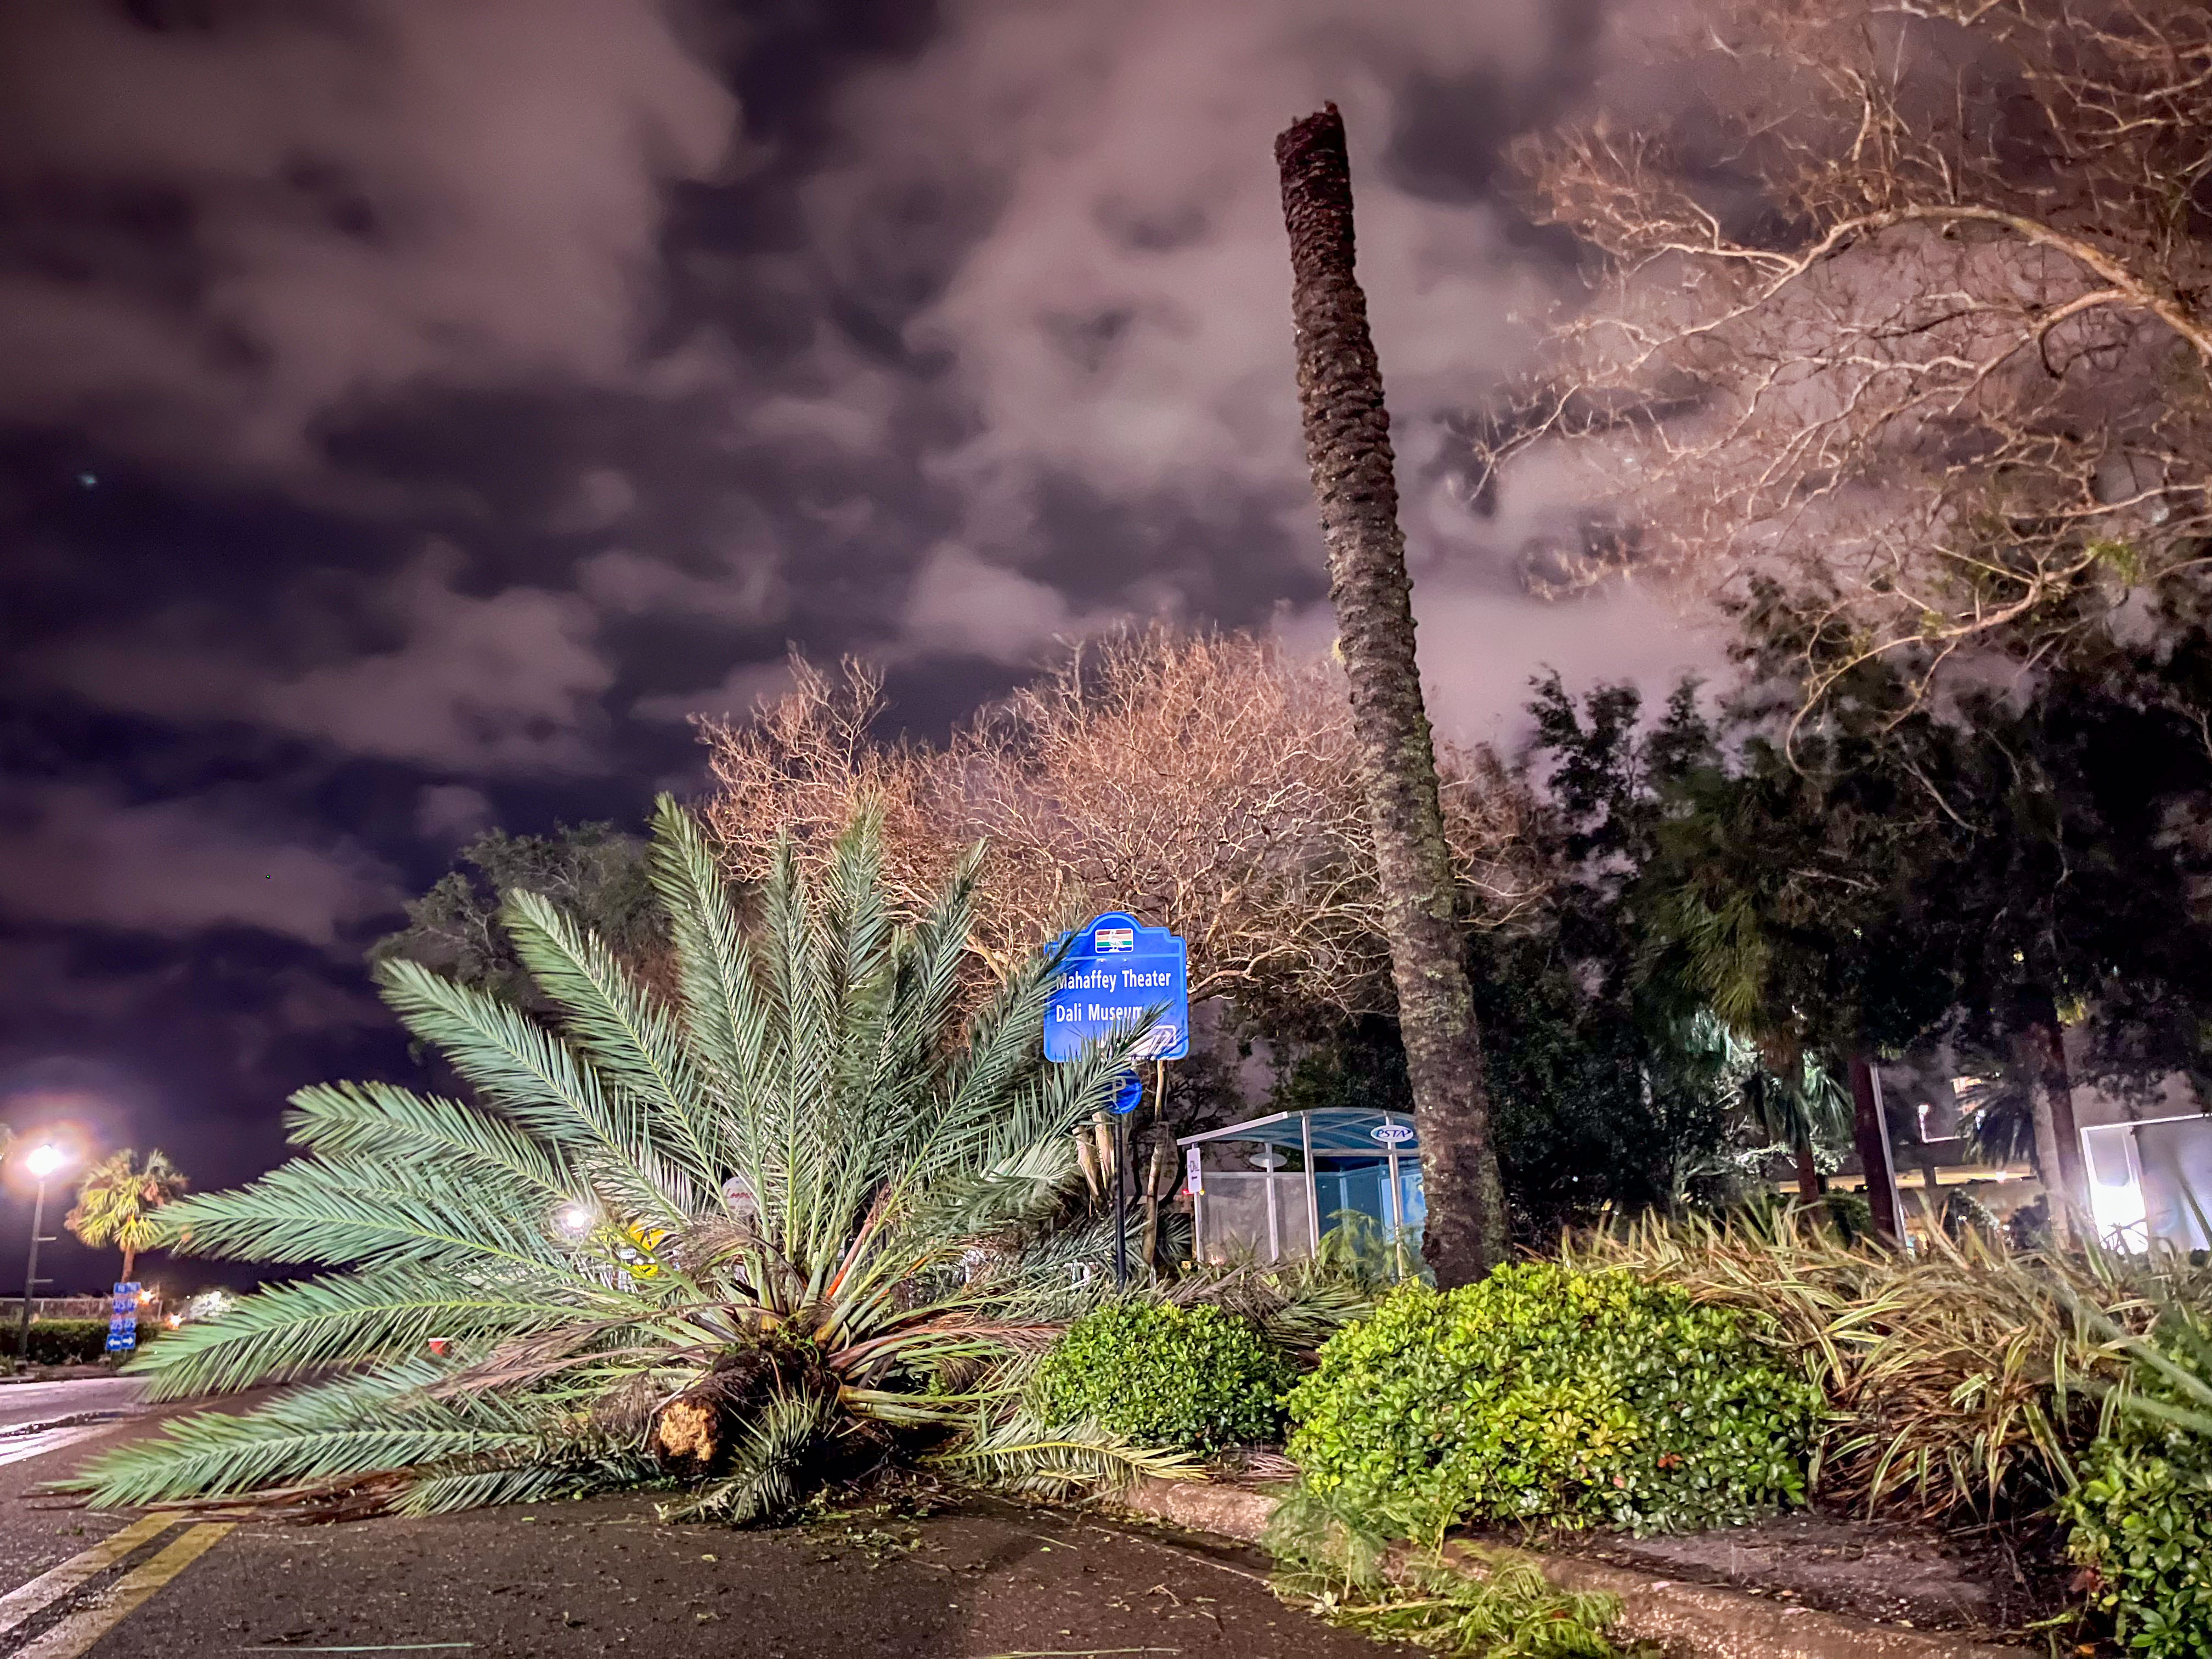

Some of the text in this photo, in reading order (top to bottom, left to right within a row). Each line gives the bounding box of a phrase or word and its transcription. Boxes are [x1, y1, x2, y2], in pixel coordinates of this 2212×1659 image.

[1057, 969, 1171, 993] Mahaffey Theater
[1056, 1003, 1142, 1022] Dali Museum
